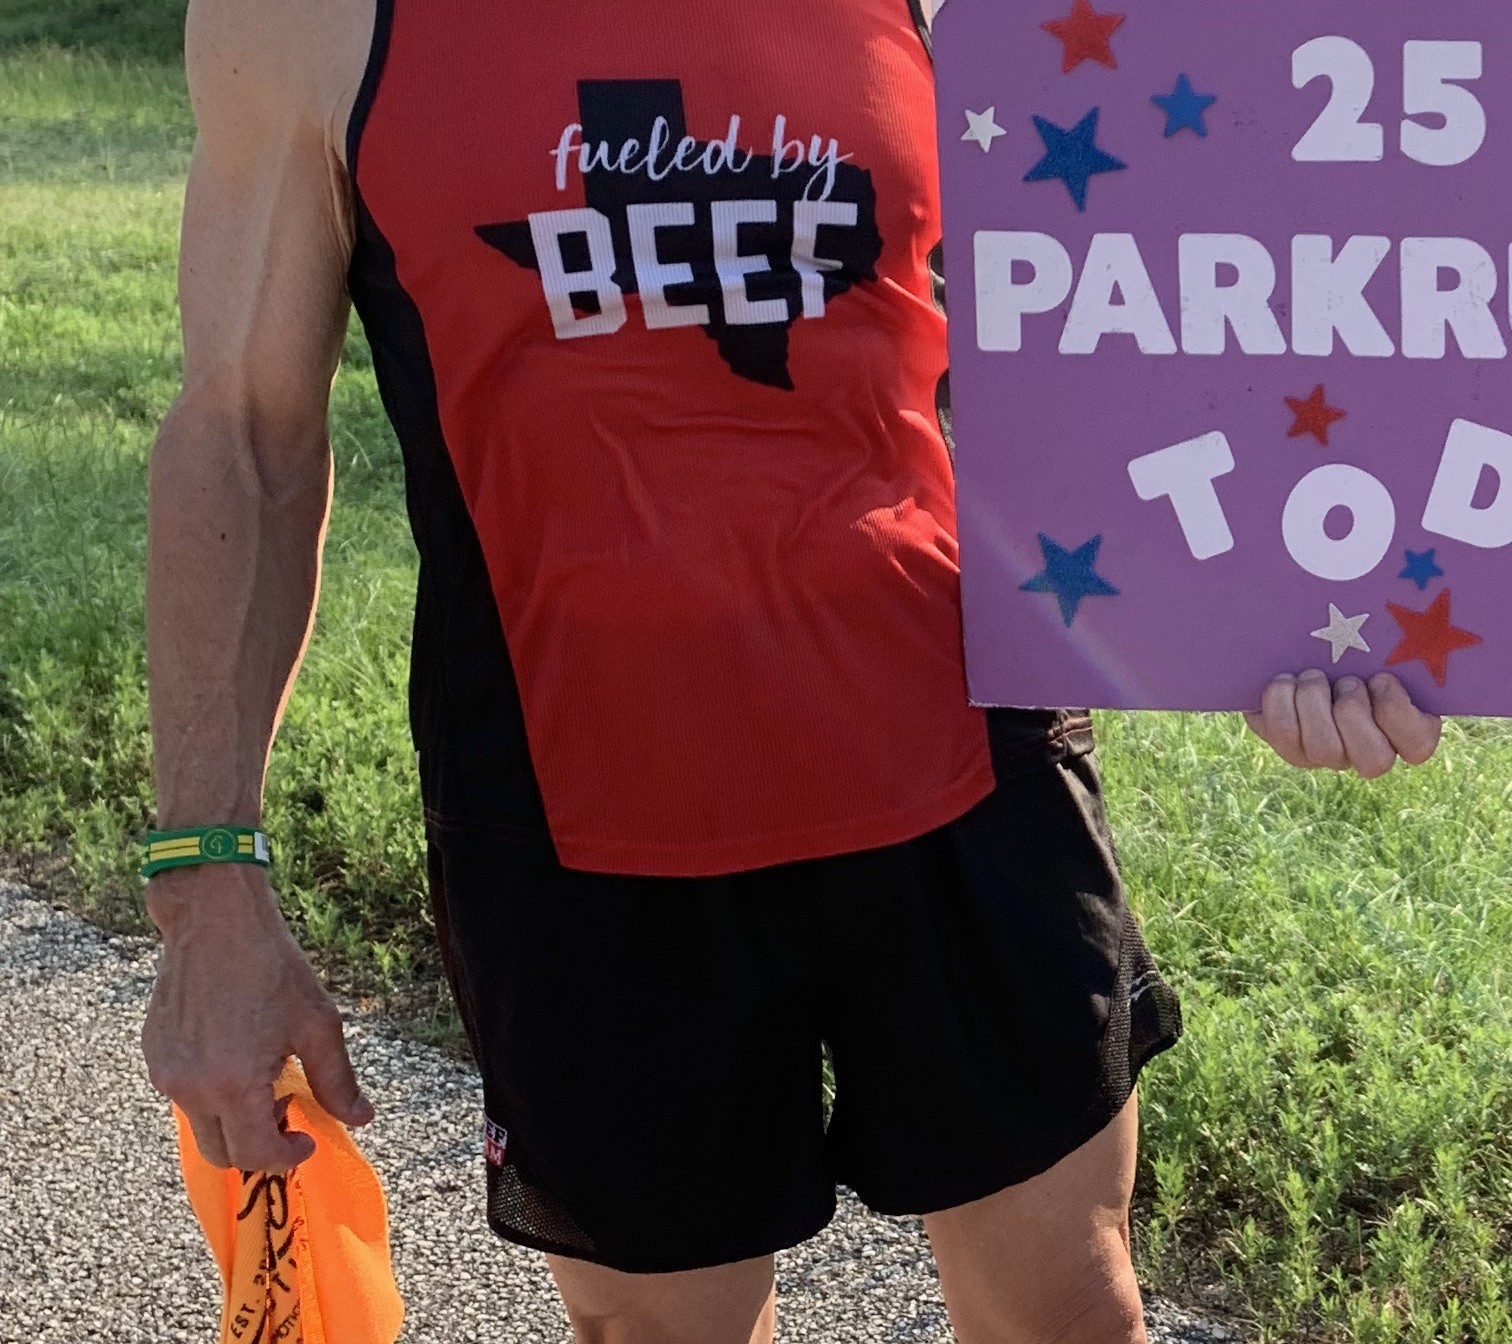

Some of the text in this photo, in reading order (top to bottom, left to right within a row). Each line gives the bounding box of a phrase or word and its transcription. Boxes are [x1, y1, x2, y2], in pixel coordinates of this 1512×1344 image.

[549, 114, 855, 203] fueled by
[1290, 35, 1487, 166] 25
[527, 199, 858, 340] BEEF
